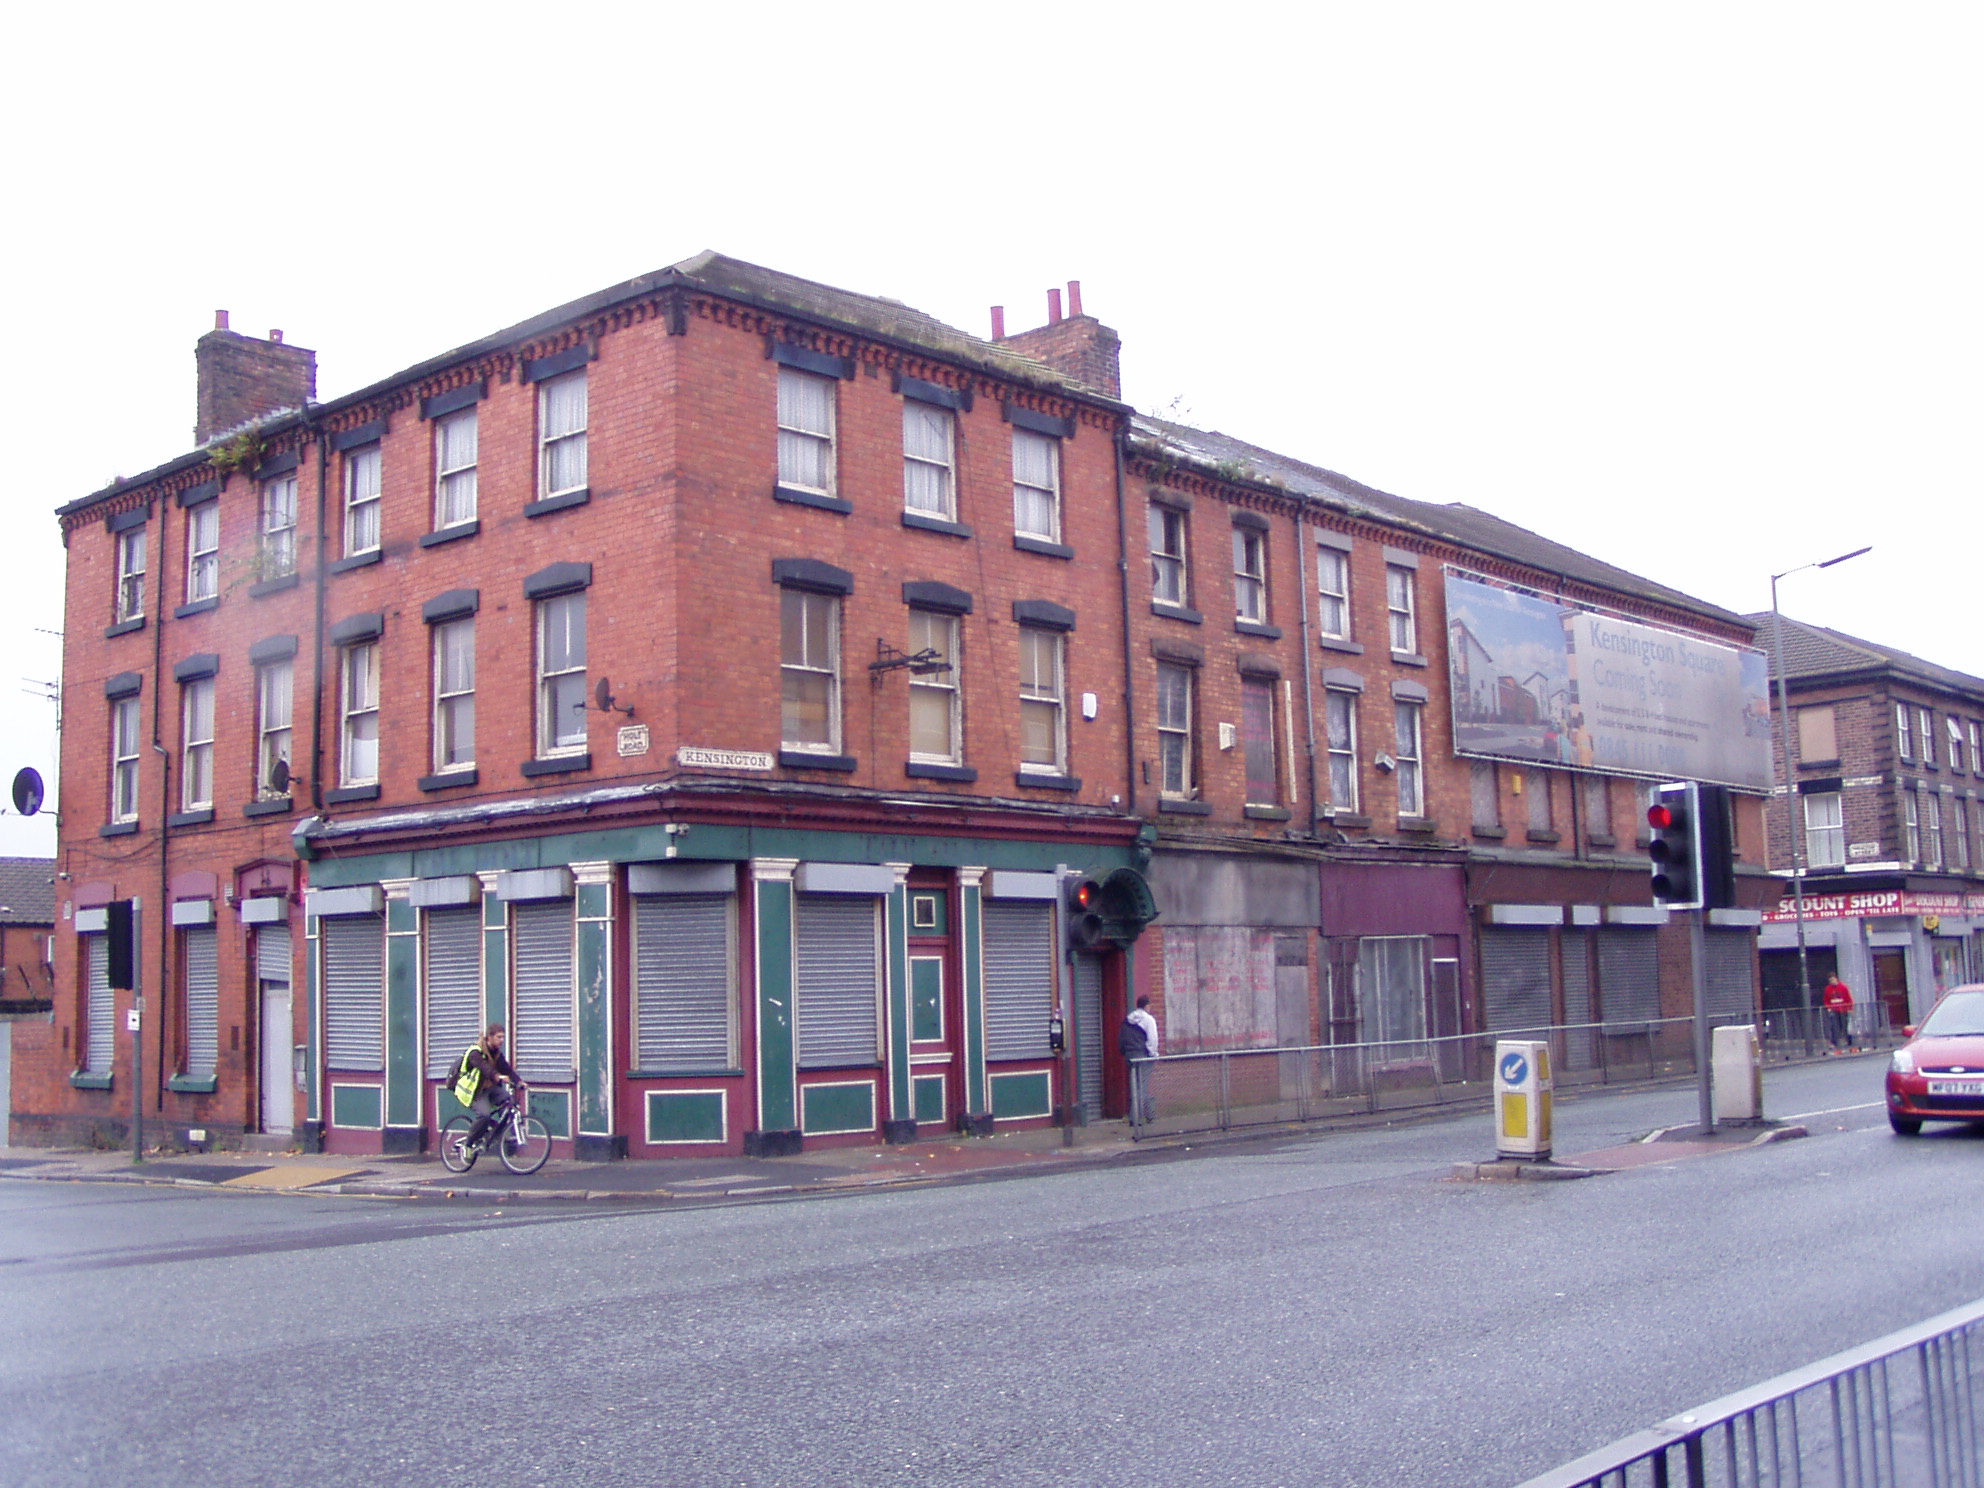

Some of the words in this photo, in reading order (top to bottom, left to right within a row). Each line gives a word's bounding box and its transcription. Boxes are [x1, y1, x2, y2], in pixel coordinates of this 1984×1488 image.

[1590, 620, 1675, 666] Kensington
[1678, 641, 1726, 677] Square
[1593, 659, 1647, 701] Coming
[1649, 669, 1683, 698] Soon
[623, 731, 641, 740] HOLT
[623, 742, 643, 750] ROAD
[685, 751, 767, 767] KENSINGTON
[1850, 892, 1898, 909] SHOP
